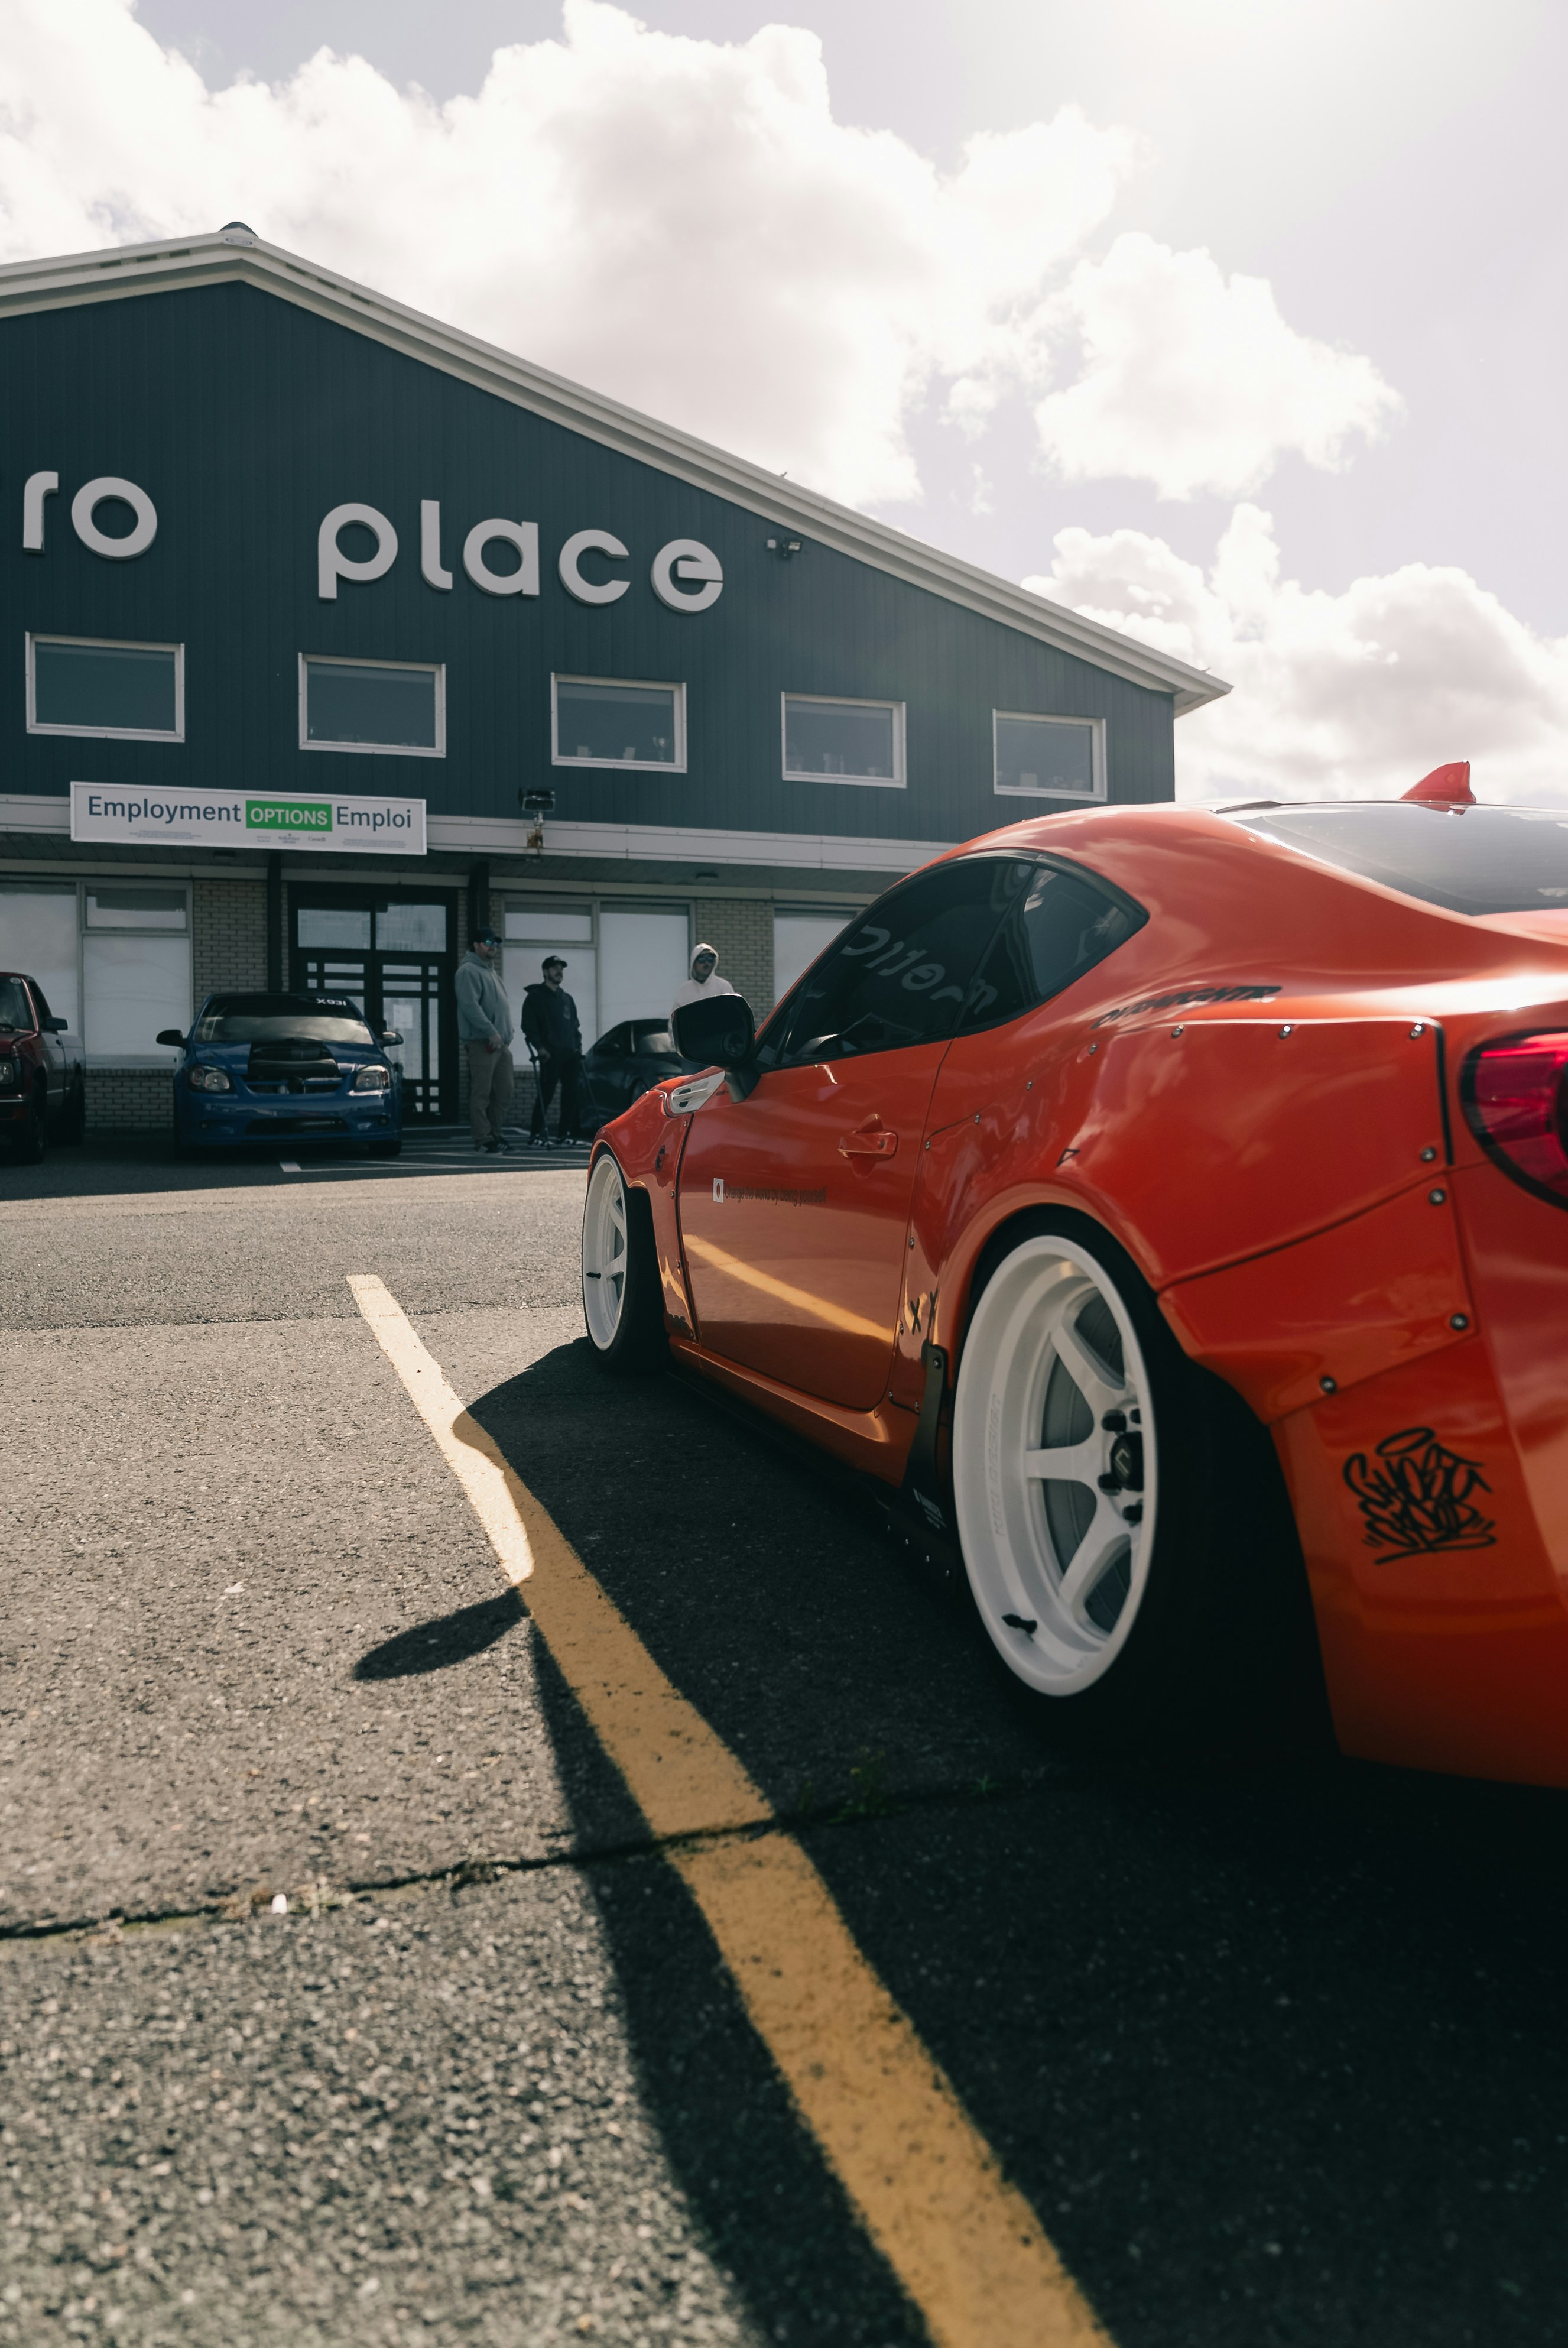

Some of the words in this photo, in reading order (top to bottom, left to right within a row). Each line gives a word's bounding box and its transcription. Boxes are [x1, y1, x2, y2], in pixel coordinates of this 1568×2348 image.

[23, 471, 158, 559] ro
[318, 499, 725, 613] place
[89, 796, 242, 825] Employment
[250, 807, 328, 826] OPTIONS
[337, 806, 411, 832] Emploi
